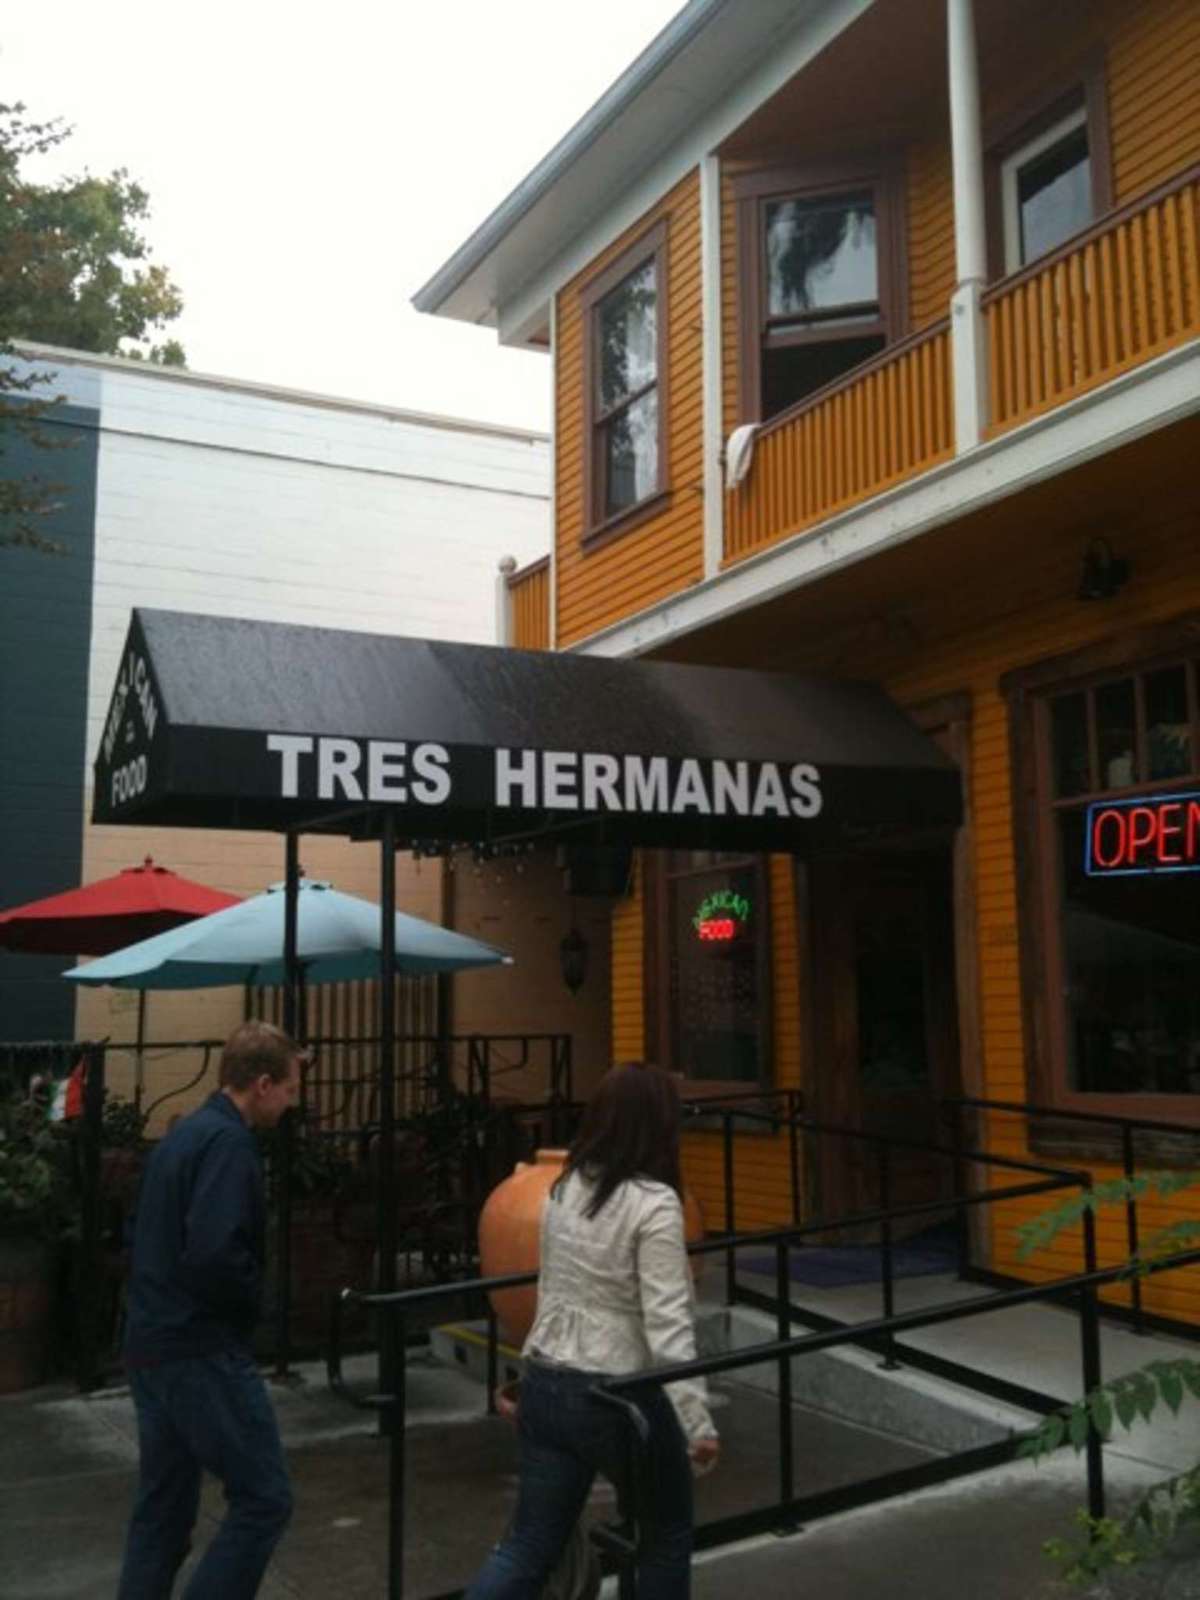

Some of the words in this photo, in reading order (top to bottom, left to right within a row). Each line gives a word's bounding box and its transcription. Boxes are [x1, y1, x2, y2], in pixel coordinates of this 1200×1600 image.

[111, 754, 147, 808] FOOD
[266, 734, 452, 805] TRES
[494, 748, 822, 819] HERMANAS
[698, 918, 735, 940] FOOD
